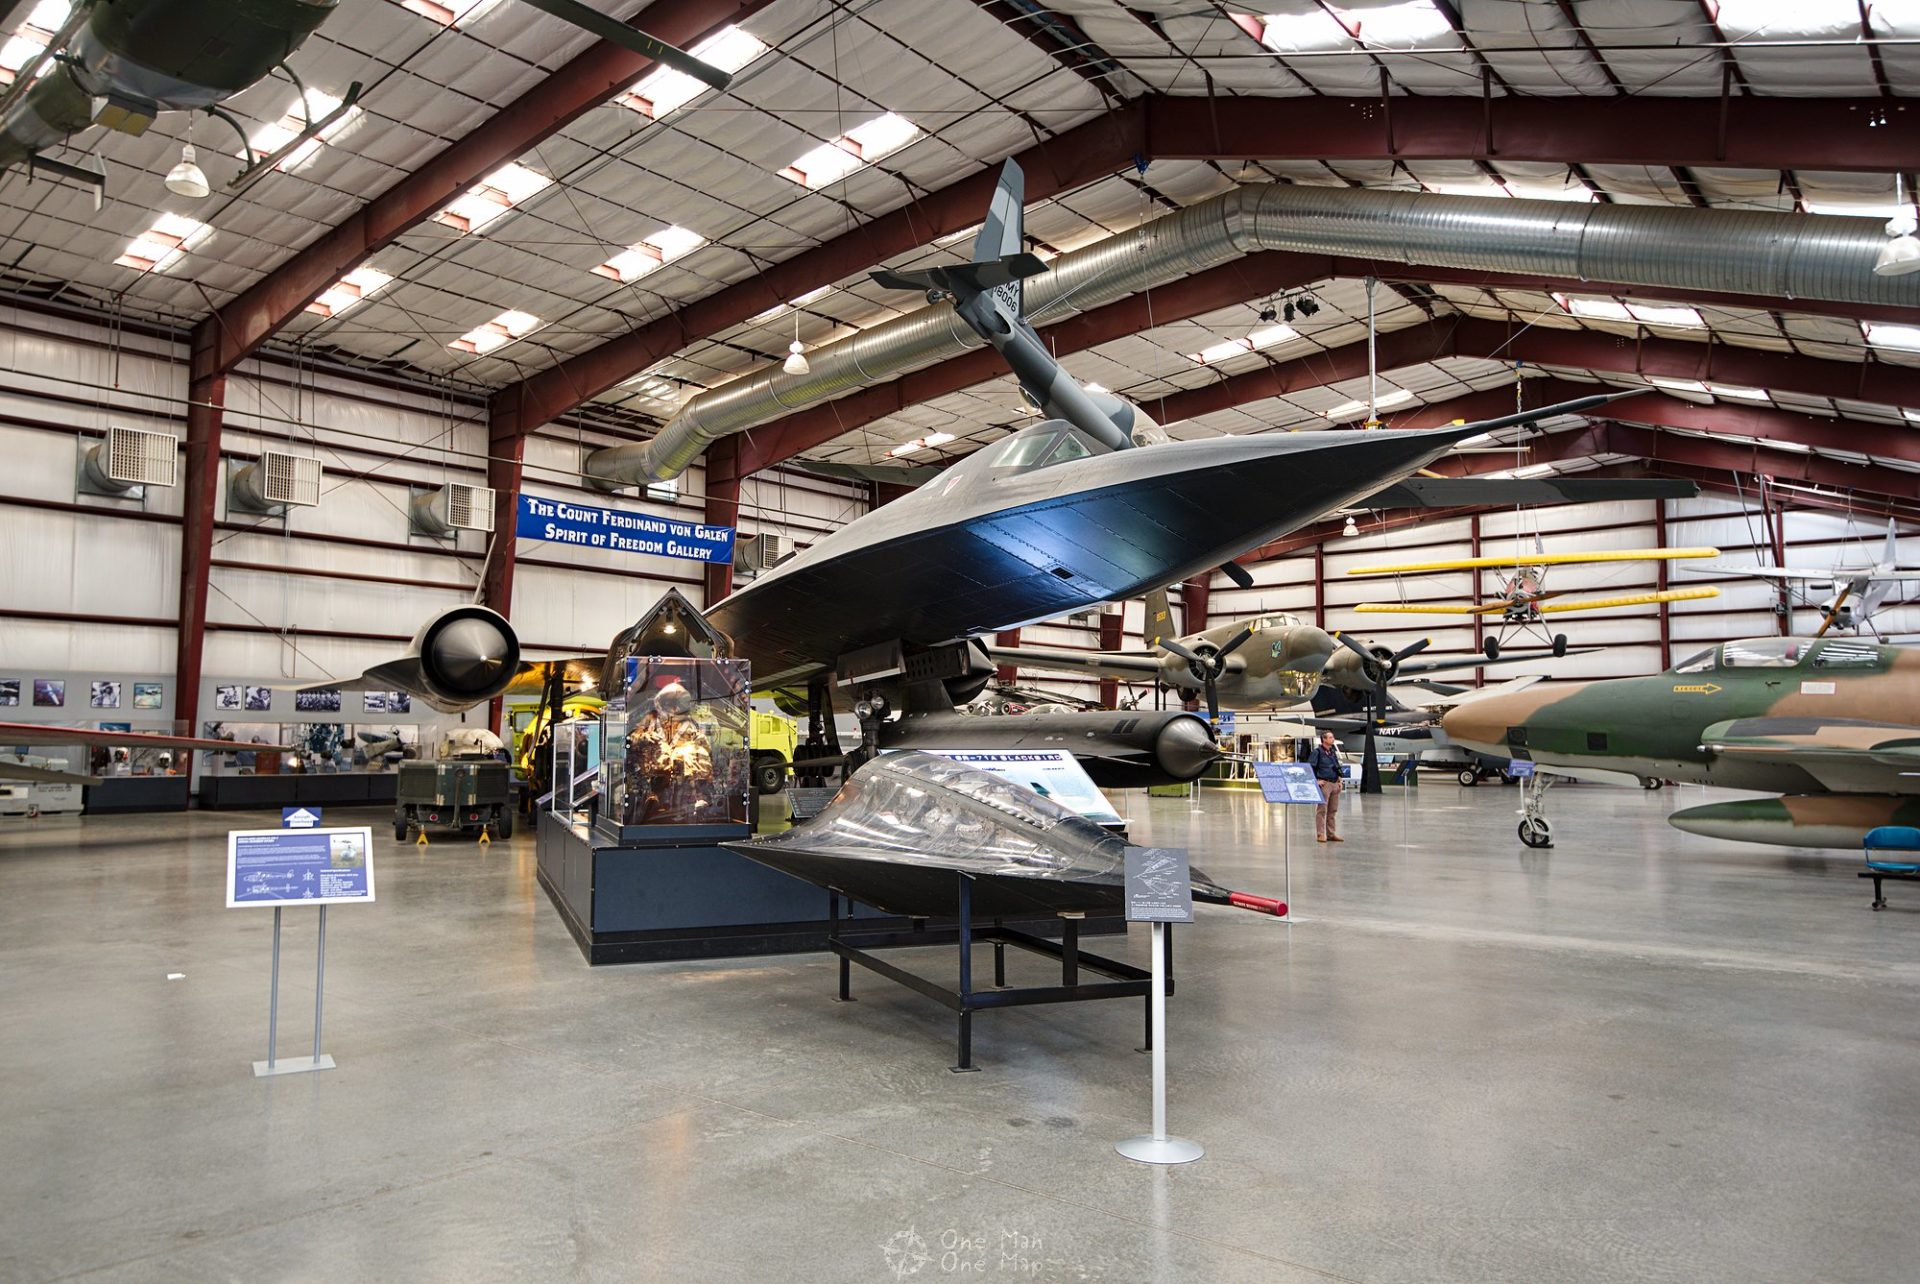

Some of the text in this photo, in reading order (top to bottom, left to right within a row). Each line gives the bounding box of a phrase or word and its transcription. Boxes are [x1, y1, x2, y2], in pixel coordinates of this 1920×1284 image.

[527, 498, 728, 543] THE COUNT FERDINAND VON GALEN
[545, 523, 712, 560] SPIRIT OF FREEDOM GALLERY
